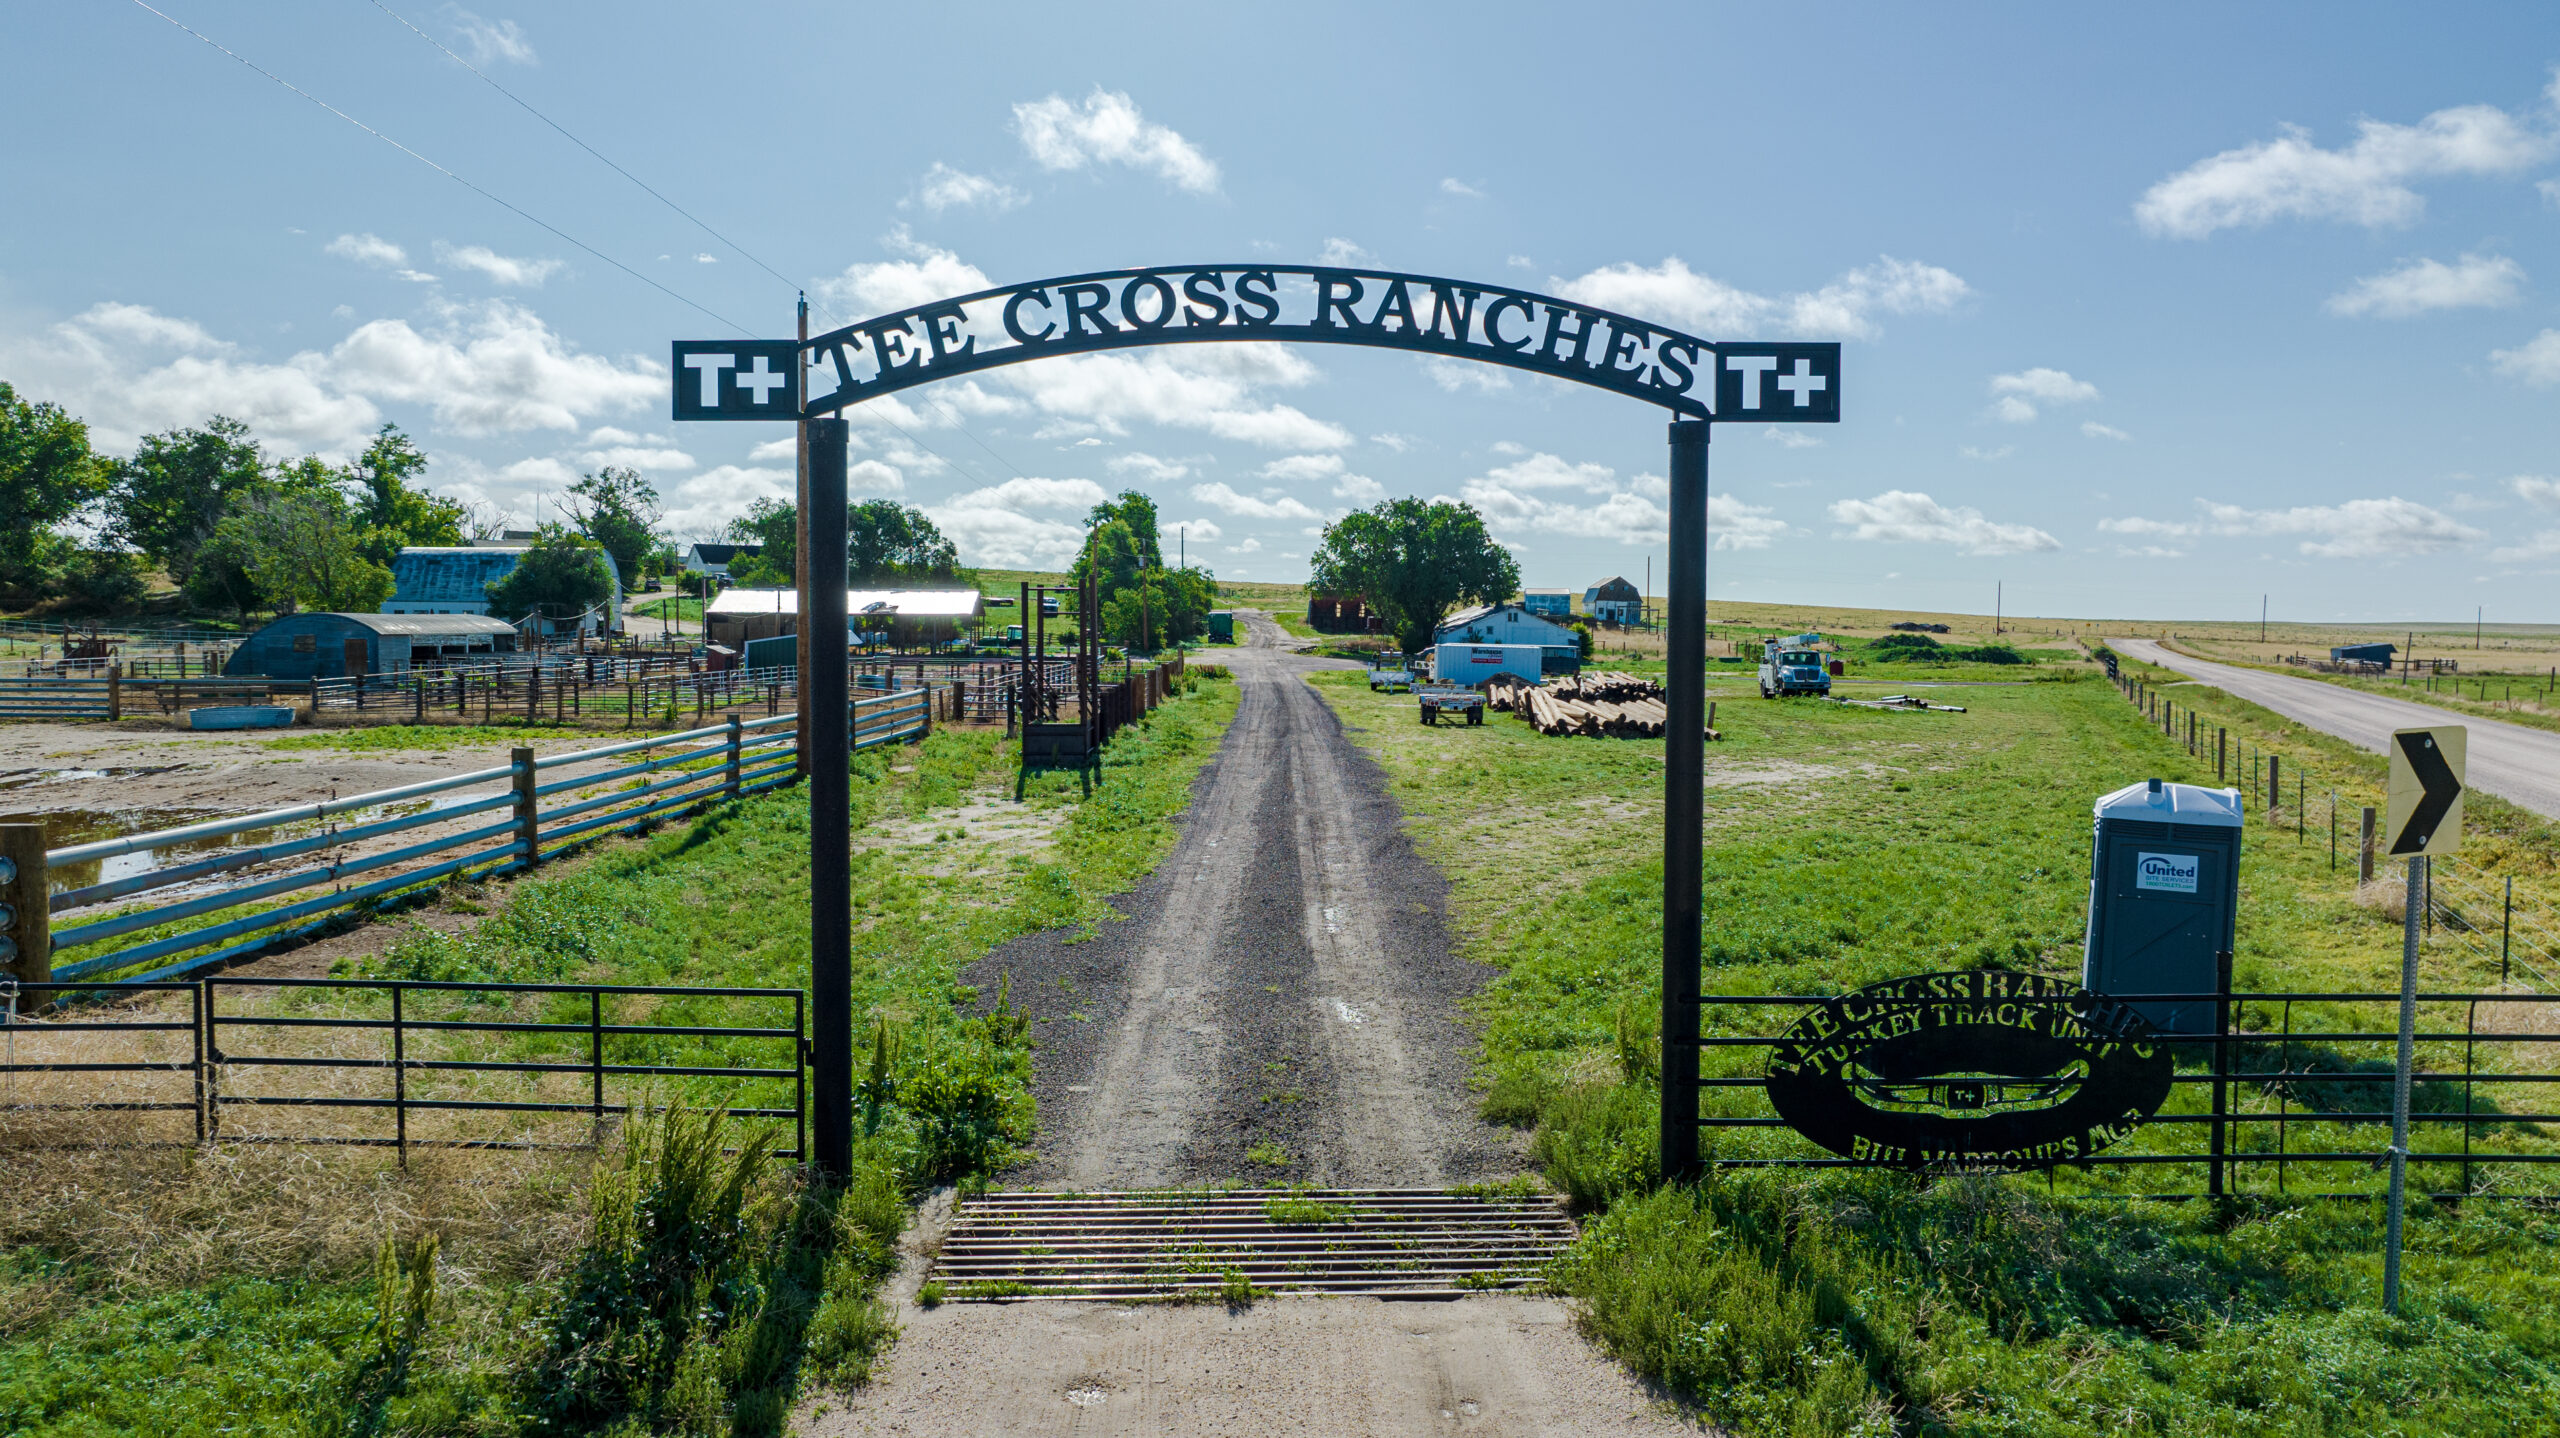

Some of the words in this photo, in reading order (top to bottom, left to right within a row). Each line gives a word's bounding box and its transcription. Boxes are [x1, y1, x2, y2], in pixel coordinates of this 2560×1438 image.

[814, 304, 975, 392] TEE
[1002, 271, 1280, 345] CROSS
[1311, 272, 1699, 395] RANCHES
[2146, 863, 2194, 877] United
[1842, 974, 1971, 1022] CROSS
[1804, 1009, 1923, 1075] TURKEY
[1930, 1002, 2037, 1031] TRACK
